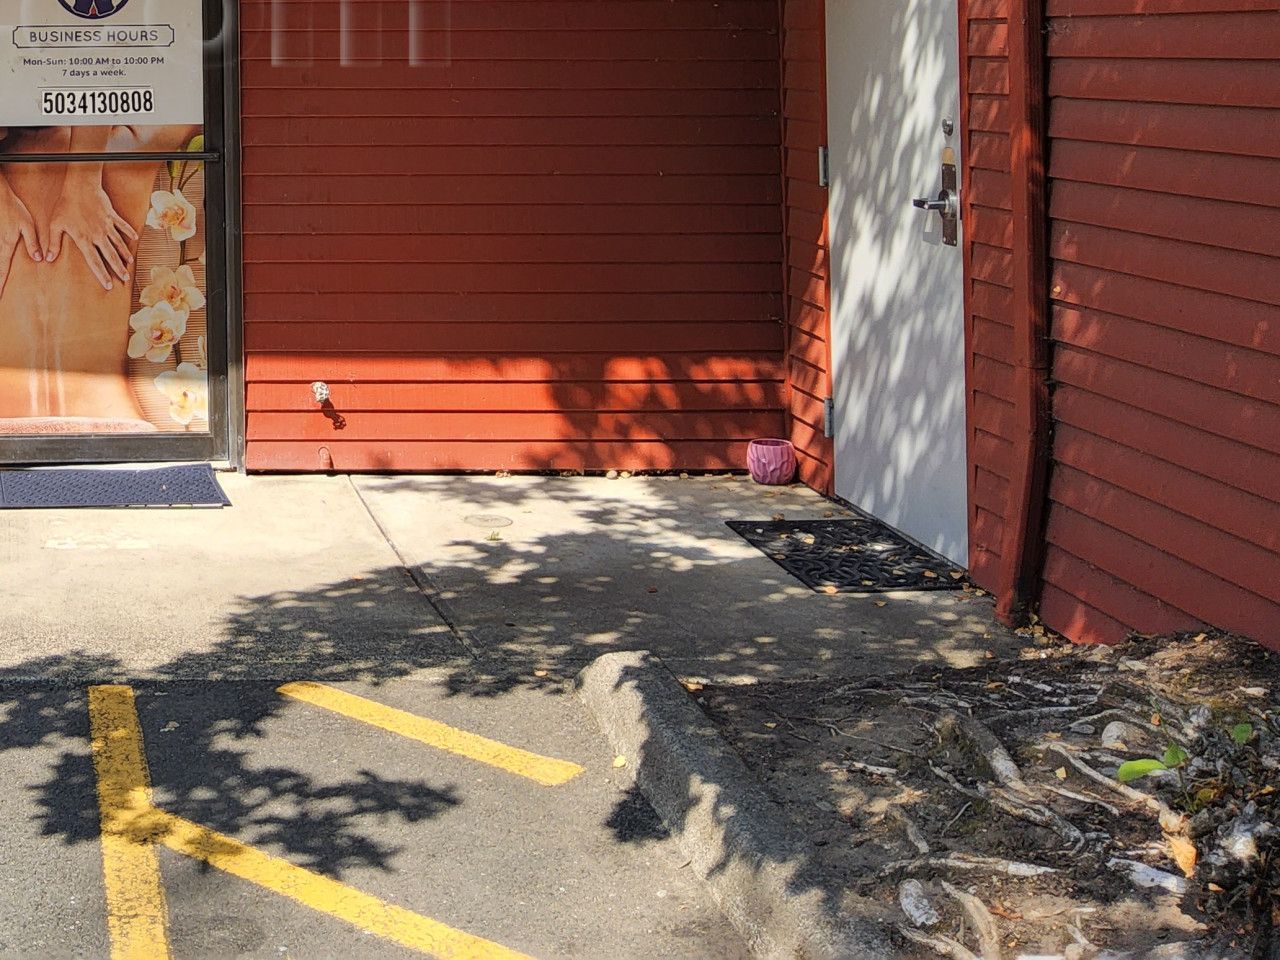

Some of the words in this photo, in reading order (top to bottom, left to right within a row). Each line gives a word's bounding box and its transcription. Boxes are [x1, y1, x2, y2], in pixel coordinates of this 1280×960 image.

[29, 30, 102, 43] BUSINESS
[107, 29, 159, 42] HOURS
[23, 57, 67, 66] Mon-Sun:
[69, 57, 94, 66] 10:00
[95, 57, 110, 66] AM
[111, 57, 121, 66] to
[124, 57, 149, 66] 10:00
[150, 57, 165, 66] PM
[62, 69, 68, 77] 7
[69, 68, 90, 78] days
[101, 68, 126, 77] week.
[43, 90, 154, 114] 5034130808
